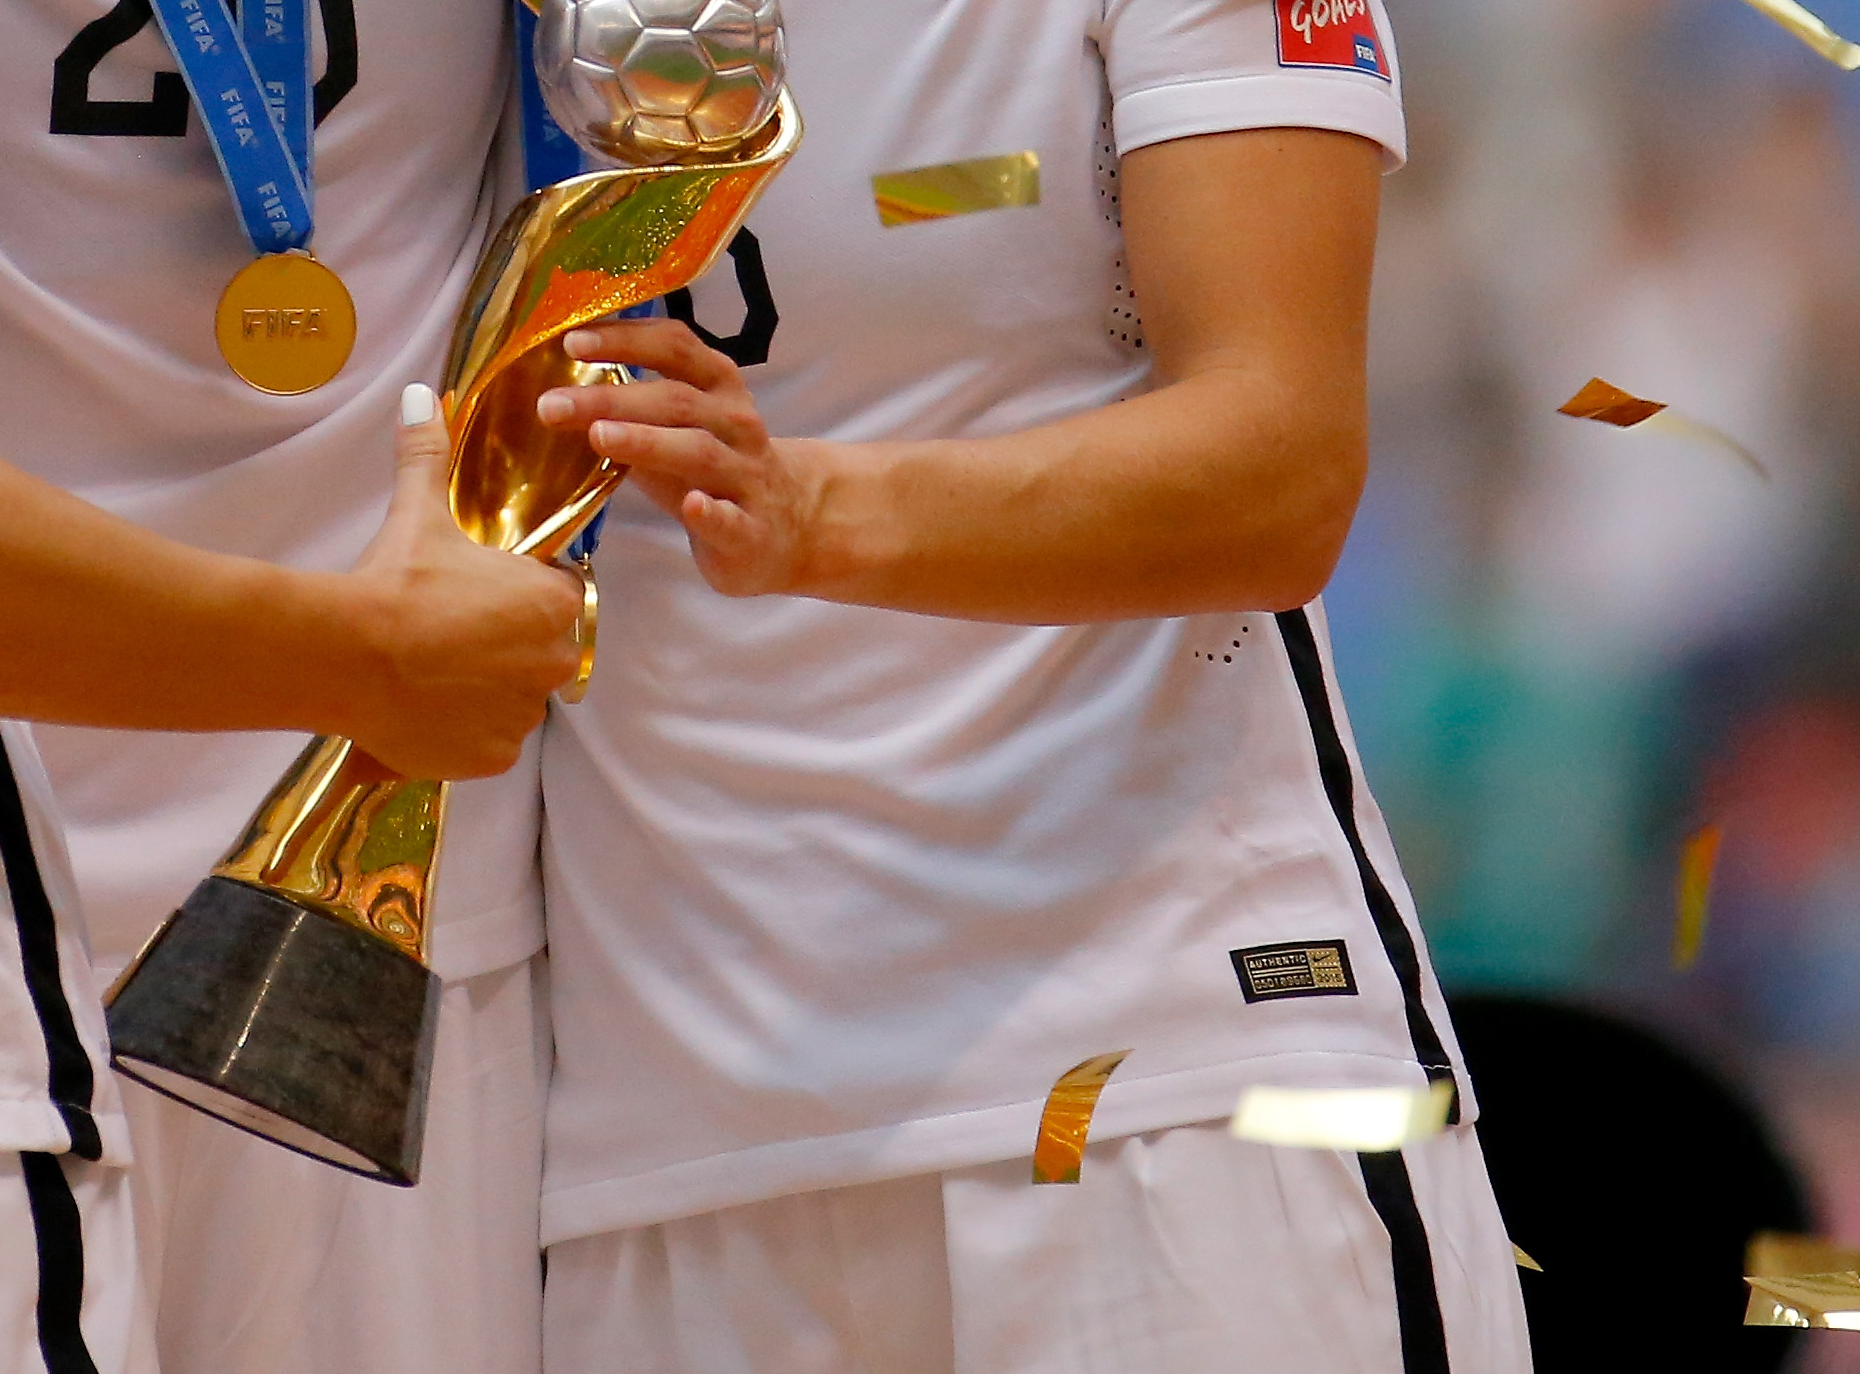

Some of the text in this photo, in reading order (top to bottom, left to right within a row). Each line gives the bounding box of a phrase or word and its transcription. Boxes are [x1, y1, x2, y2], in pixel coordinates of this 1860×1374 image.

[220, 88, 257, 147] FIFA
[265, 80, 287, 133] FIF
[257, 180, 292, 239] FIFA
[243, 308, 324, 341] FIFA
[1248, 954, 1307, 969] AUTHENTIC
